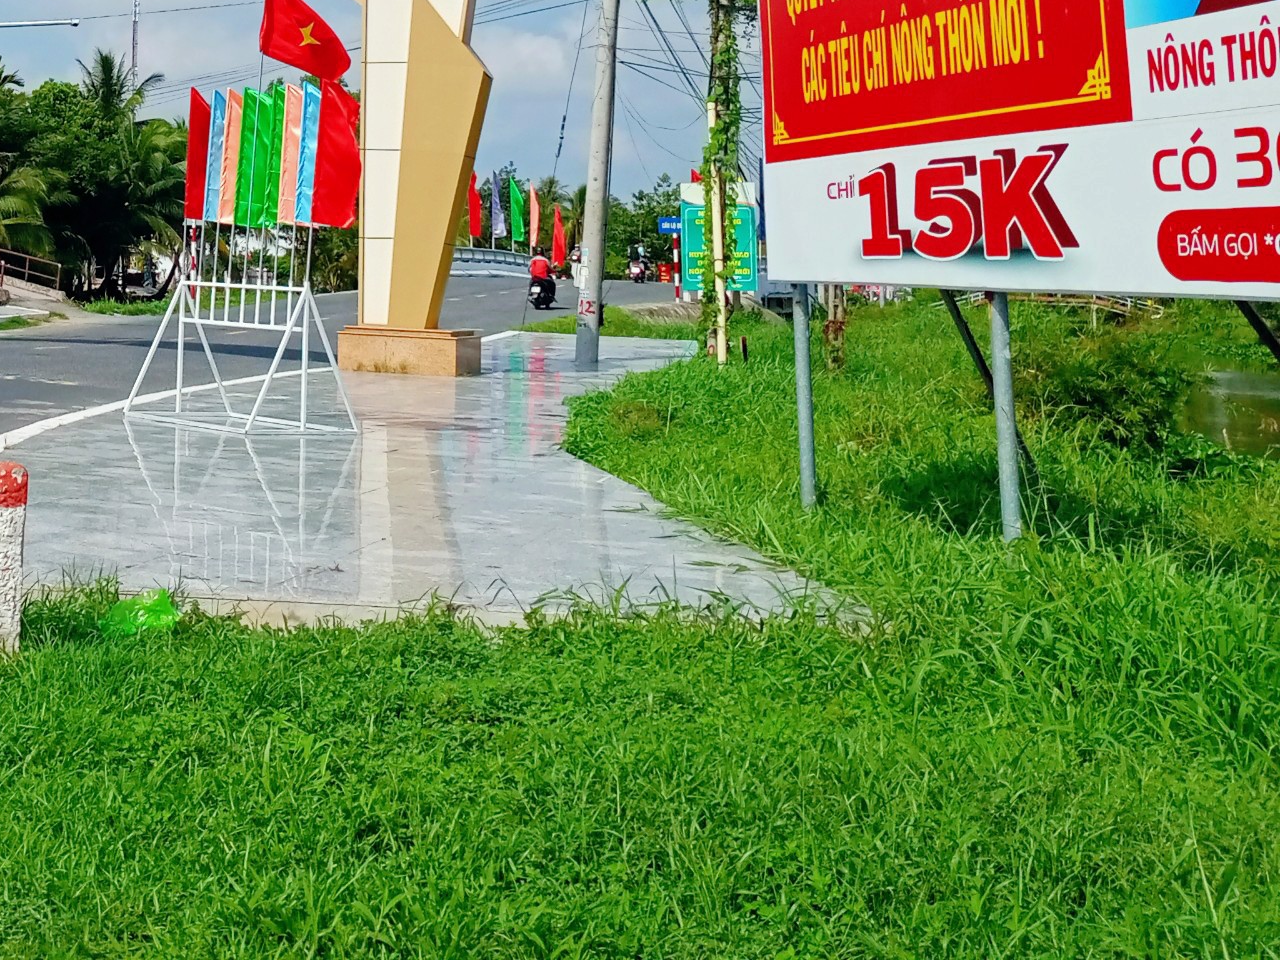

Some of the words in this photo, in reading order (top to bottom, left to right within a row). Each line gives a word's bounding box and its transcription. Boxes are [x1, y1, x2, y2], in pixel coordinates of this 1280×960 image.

[801, 29, 827, 104] CÁC
[828, 20, 860, 98] TIÊU
[862, 9, 888, 91] CHÍ
[890, 2, 935, 86] NÔNG
[1147, 33, 1216, 93] NÔNG
[1221, 14, 1280, 82] THÔ
[1152, 127, 1217, 192] CÓ
[1233, 126, 1280, 188] 3
[858, 143, 1081, 262] 15K
[1177, 225, 1219, 257] BẤM
[1224, 232, 1258, 260] GỌI
